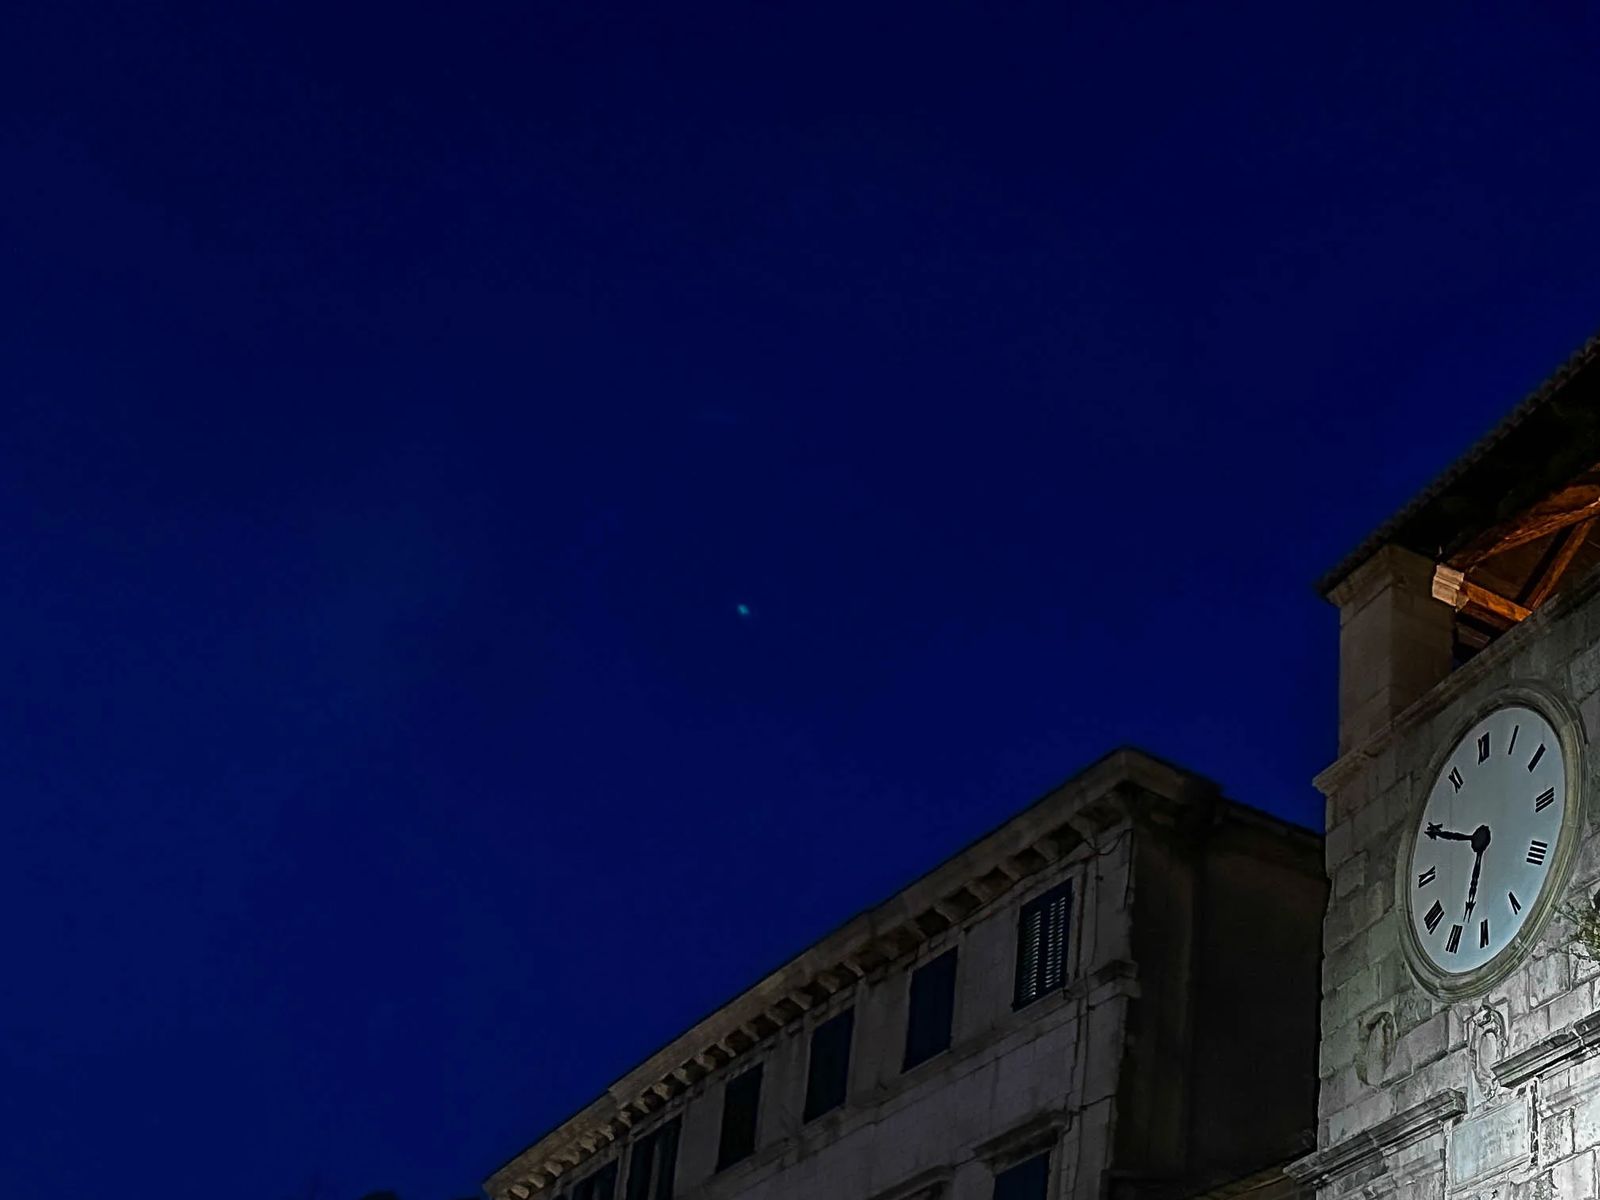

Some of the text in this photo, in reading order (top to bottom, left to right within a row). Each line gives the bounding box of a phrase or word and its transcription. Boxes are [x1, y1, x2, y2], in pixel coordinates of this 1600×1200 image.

[1508, 725, 1519, 755] I
[1535, 787, 1555, 813] III
[1526, 839, 1548, 866] IIII
[1508, 891, 1522, 915] V
